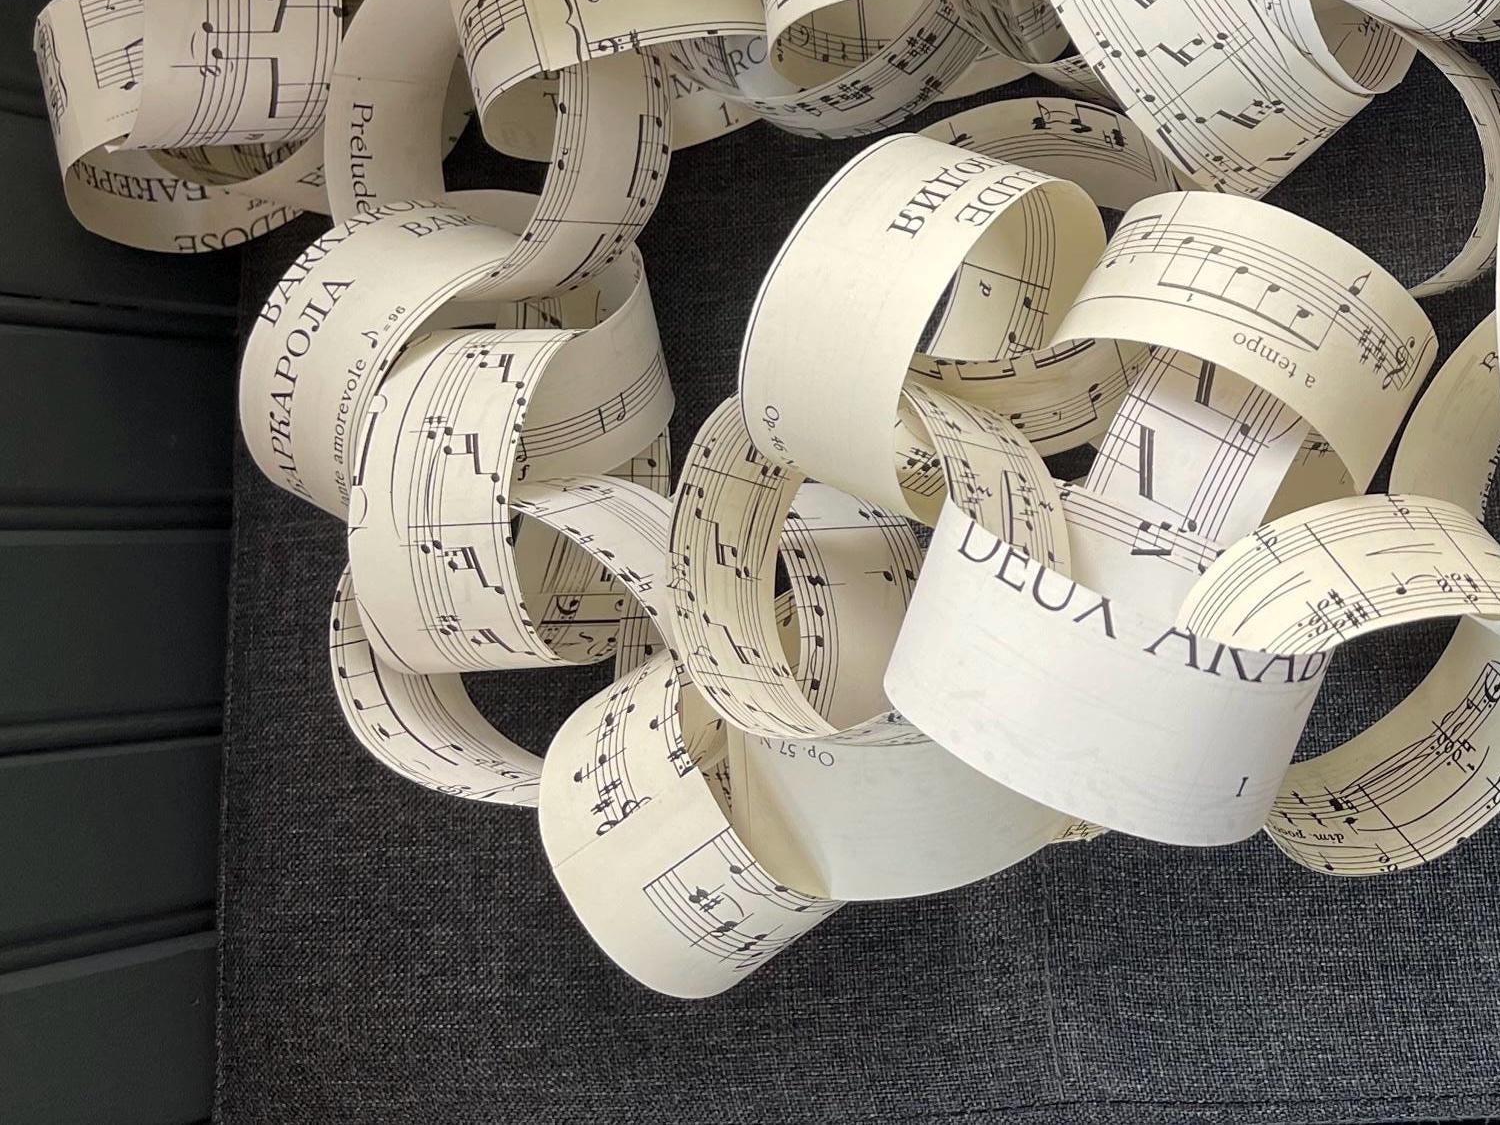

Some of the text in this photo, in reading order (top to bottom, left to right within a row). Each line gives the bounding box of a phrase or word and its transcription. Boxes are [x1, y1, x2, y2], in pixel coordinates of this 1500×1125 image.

[350, 102, 377, 220] Prélude
[1232, 331, 1317, 389] a tempo
[332, 358, 367, 465] amorevole
[762, 405, 780, 432] Op.
[803, 744, 835, 767] Op.
